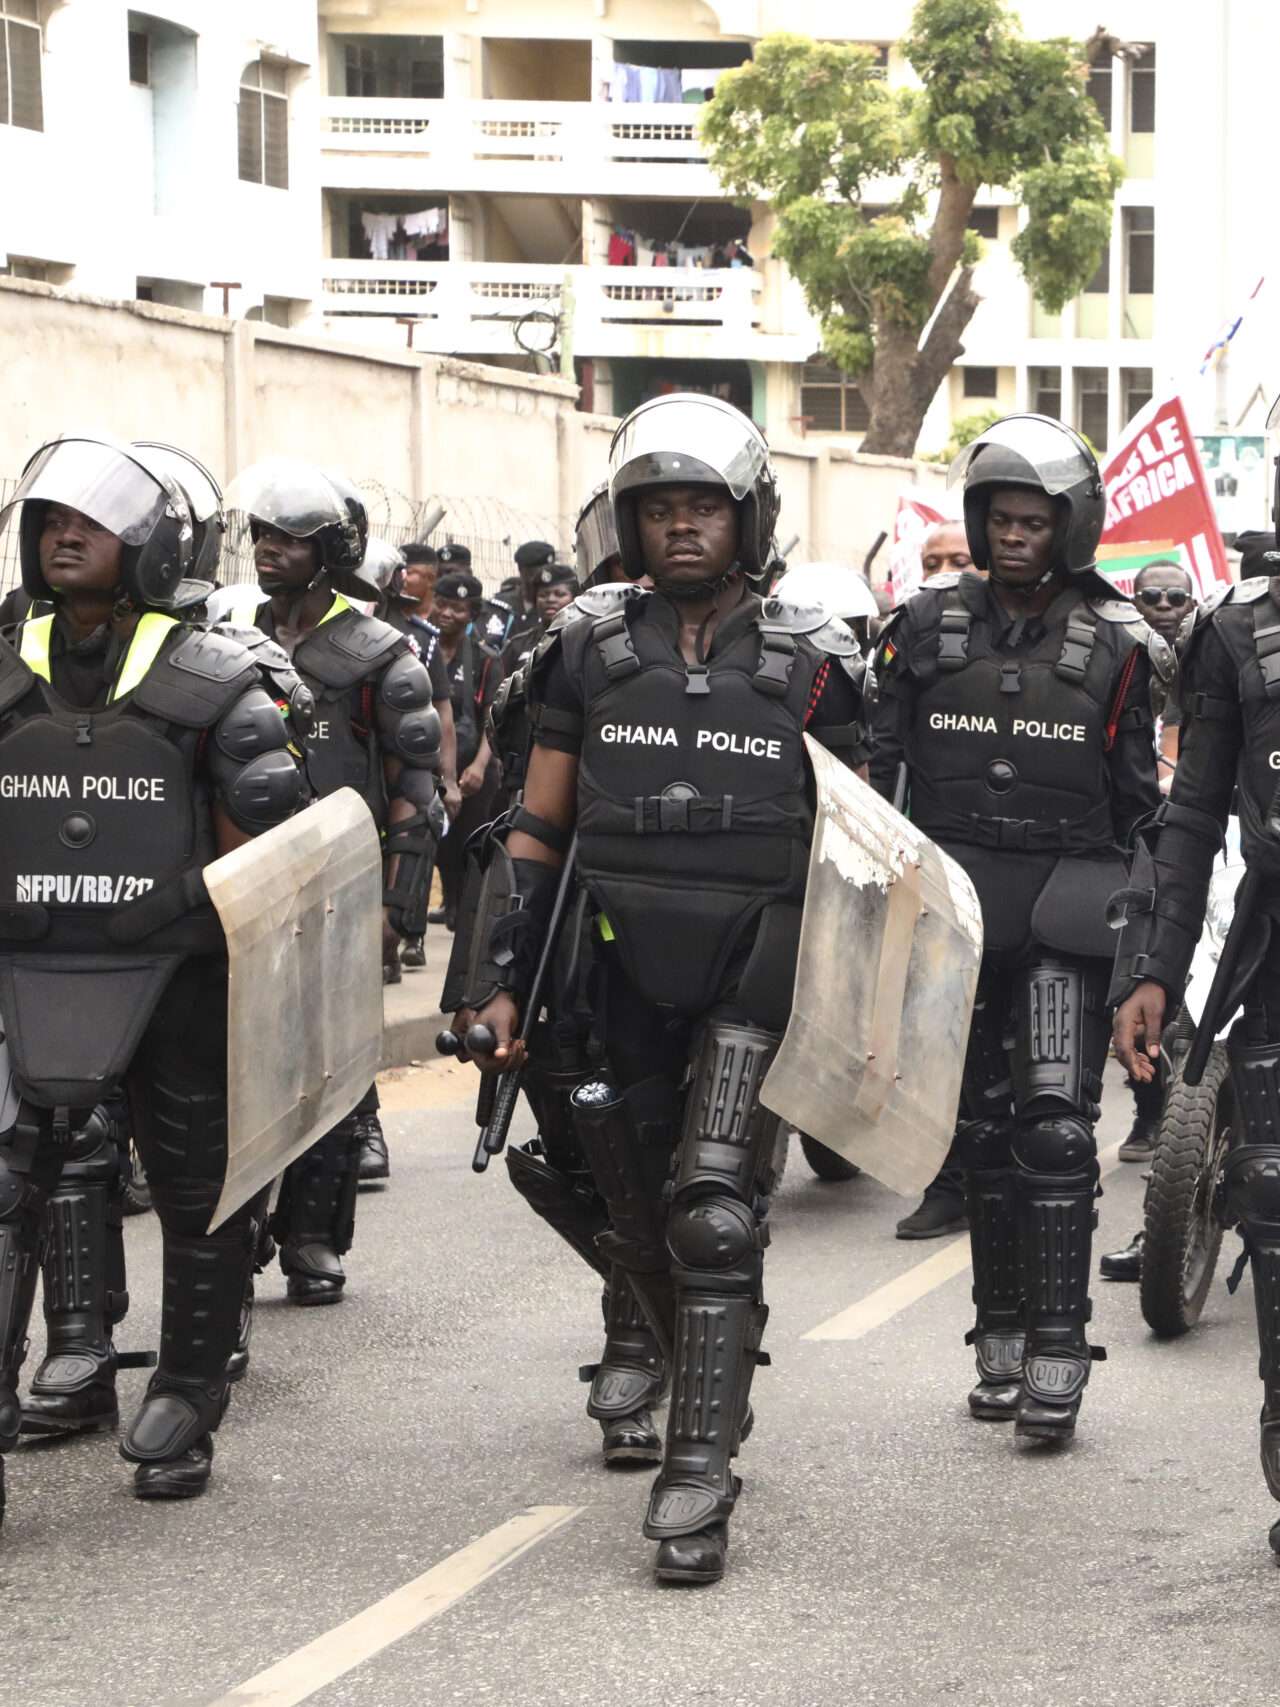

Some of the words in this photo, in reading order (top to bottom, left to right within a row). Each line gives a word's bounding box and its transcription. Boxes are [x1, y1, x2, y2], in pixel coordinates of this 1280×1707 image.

[1104, 453, 1195, 532] AFRICA
[600, 723, 679, 747] GHANA
[696, 730, 782, 760] POLICE
[929, 713, 998, 734] GHANA
[1012, 719, 1086, 742] POLICE
[0, 775, 71, 799] GHANA
[82, 775, 165, 801] POLICE
